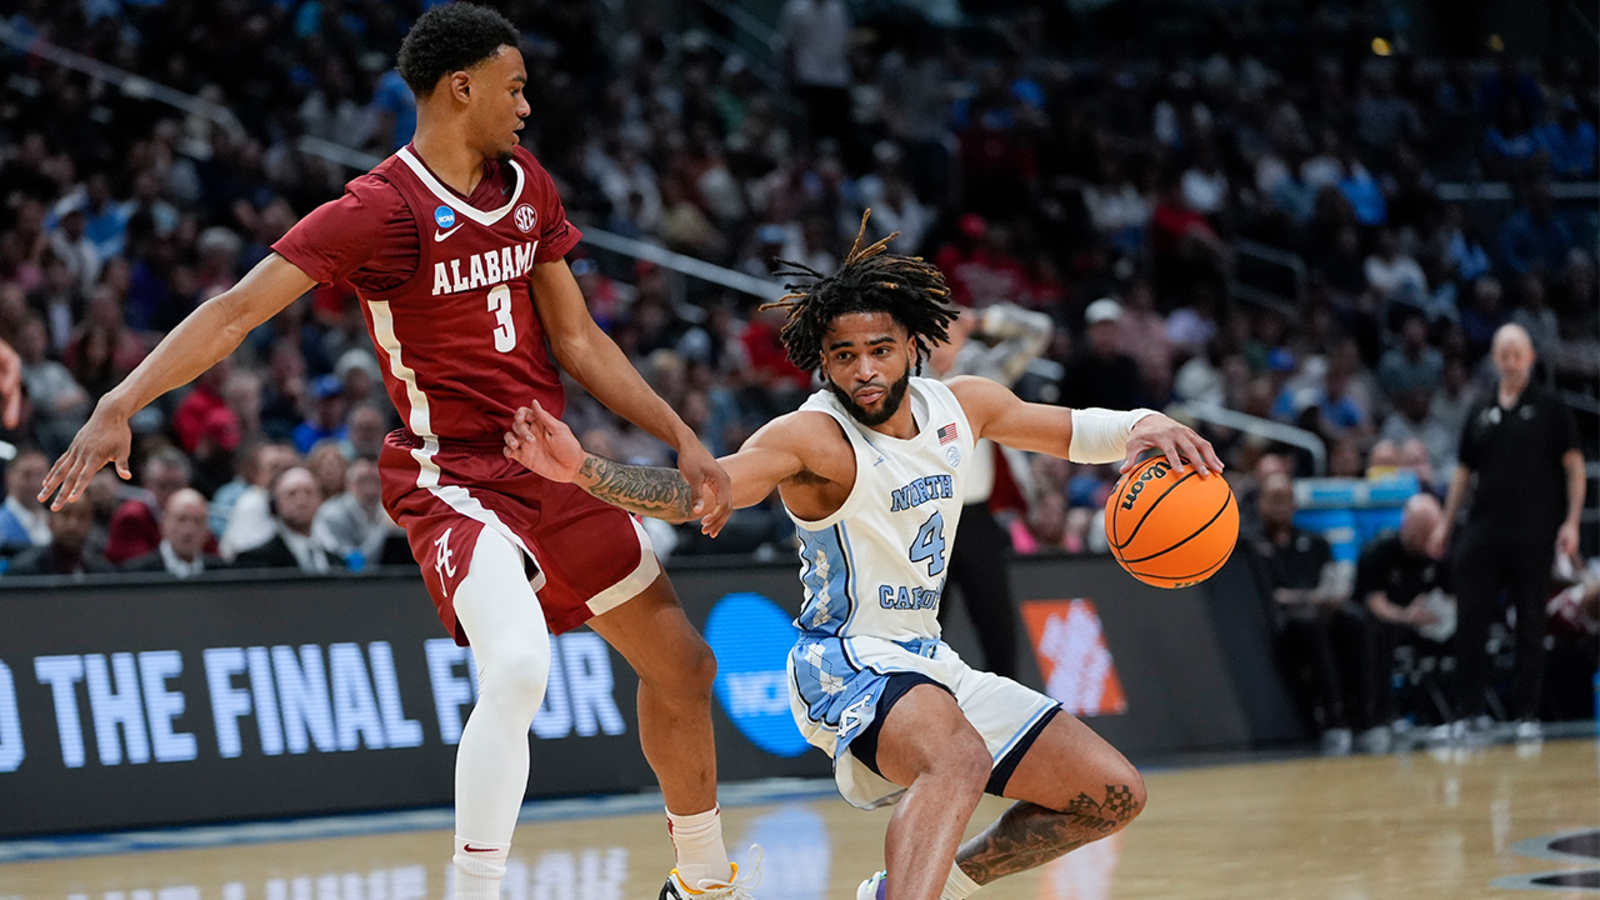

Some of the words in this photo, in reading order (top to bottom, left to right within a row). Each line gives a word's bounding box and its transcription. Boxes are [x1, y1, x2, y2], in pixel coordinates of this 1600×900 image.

[516, 205, 535, 231] SEC
[487, 283, 516, 353] 3
[909, 510, 946, 578] 4
[33, 649, 198, 768] THE
[202, 640, 424, 758] FINAL
[424, 631, 627, 745] FUR
